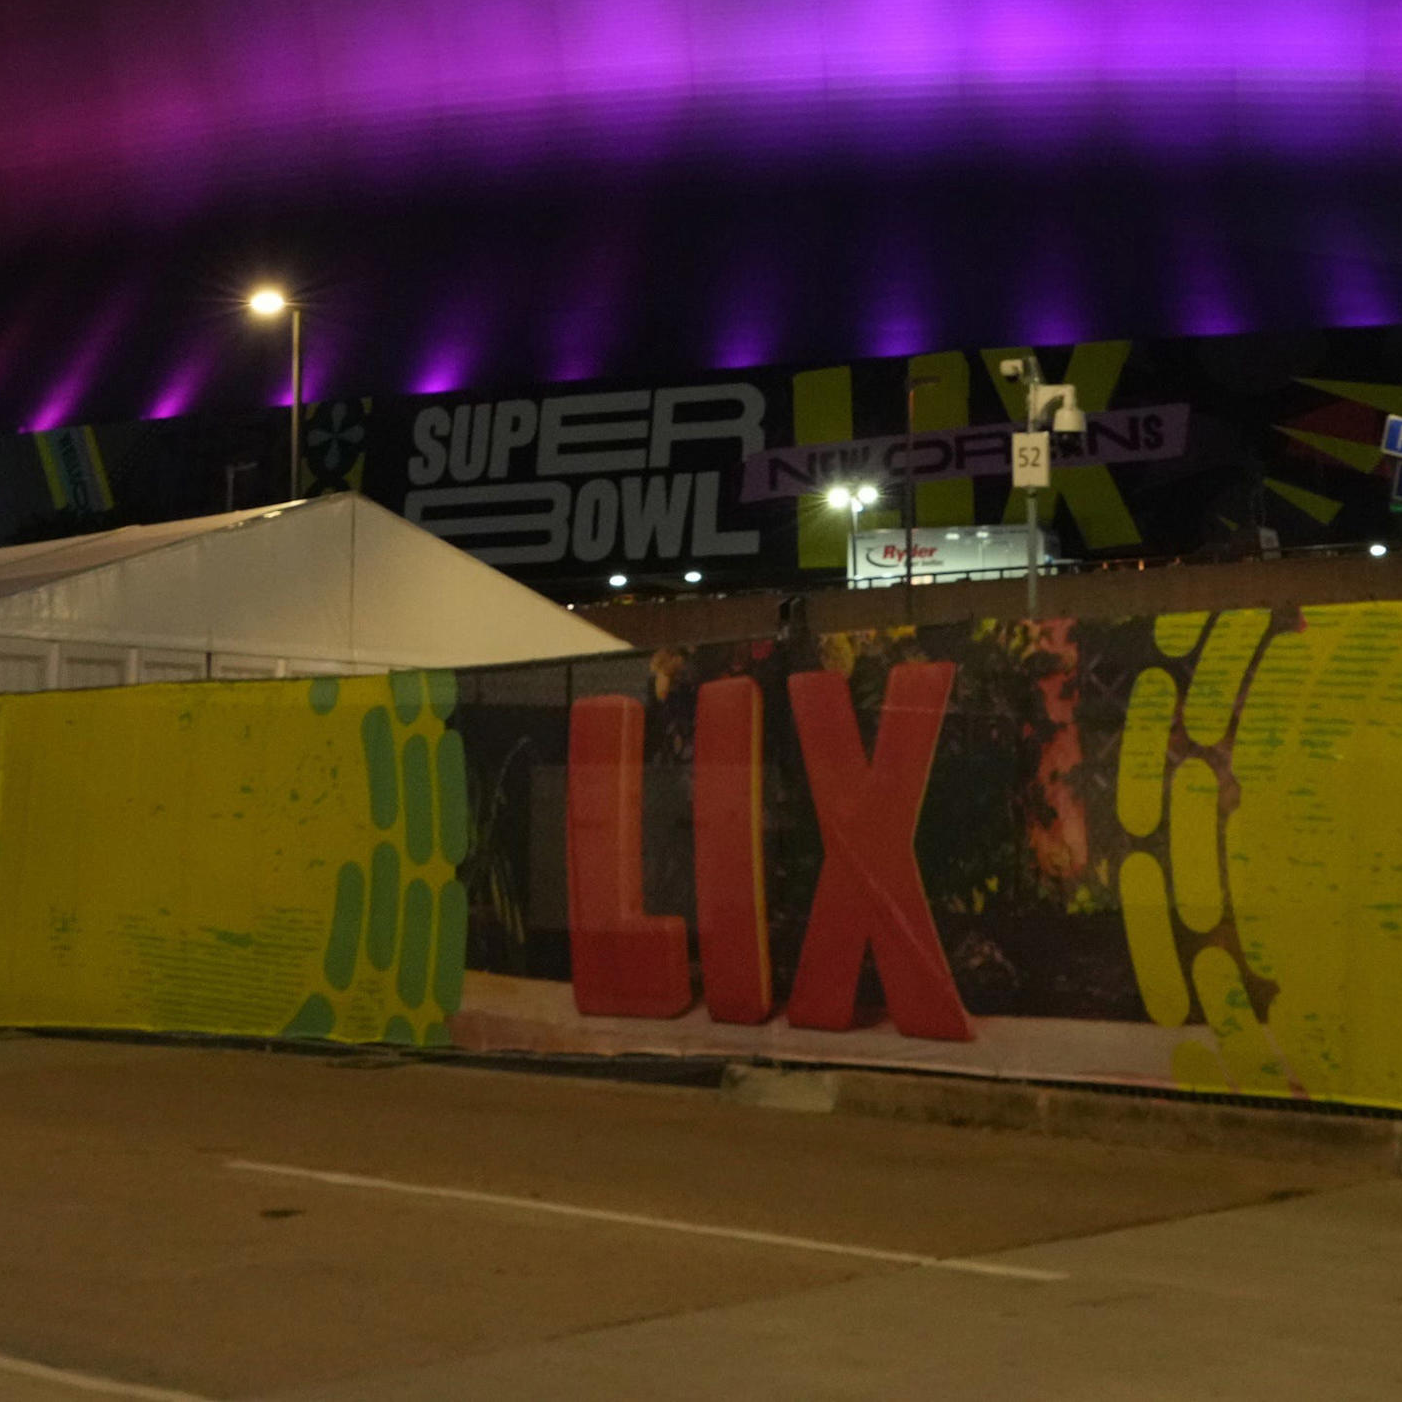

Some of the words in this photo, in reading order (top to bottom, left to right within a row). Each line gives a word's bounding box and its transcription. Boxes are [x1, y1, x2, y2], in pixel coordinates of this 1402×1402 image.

[407, 382, 767, 486] SUPER
[767, 444, 871, 491] NEW
[1018, 446, 1041, 468] 52
[404, 470, 761, 565] BOWL
[883, 544, 938, 563] Ryder
[565, 660, 976, 1042] LIX
